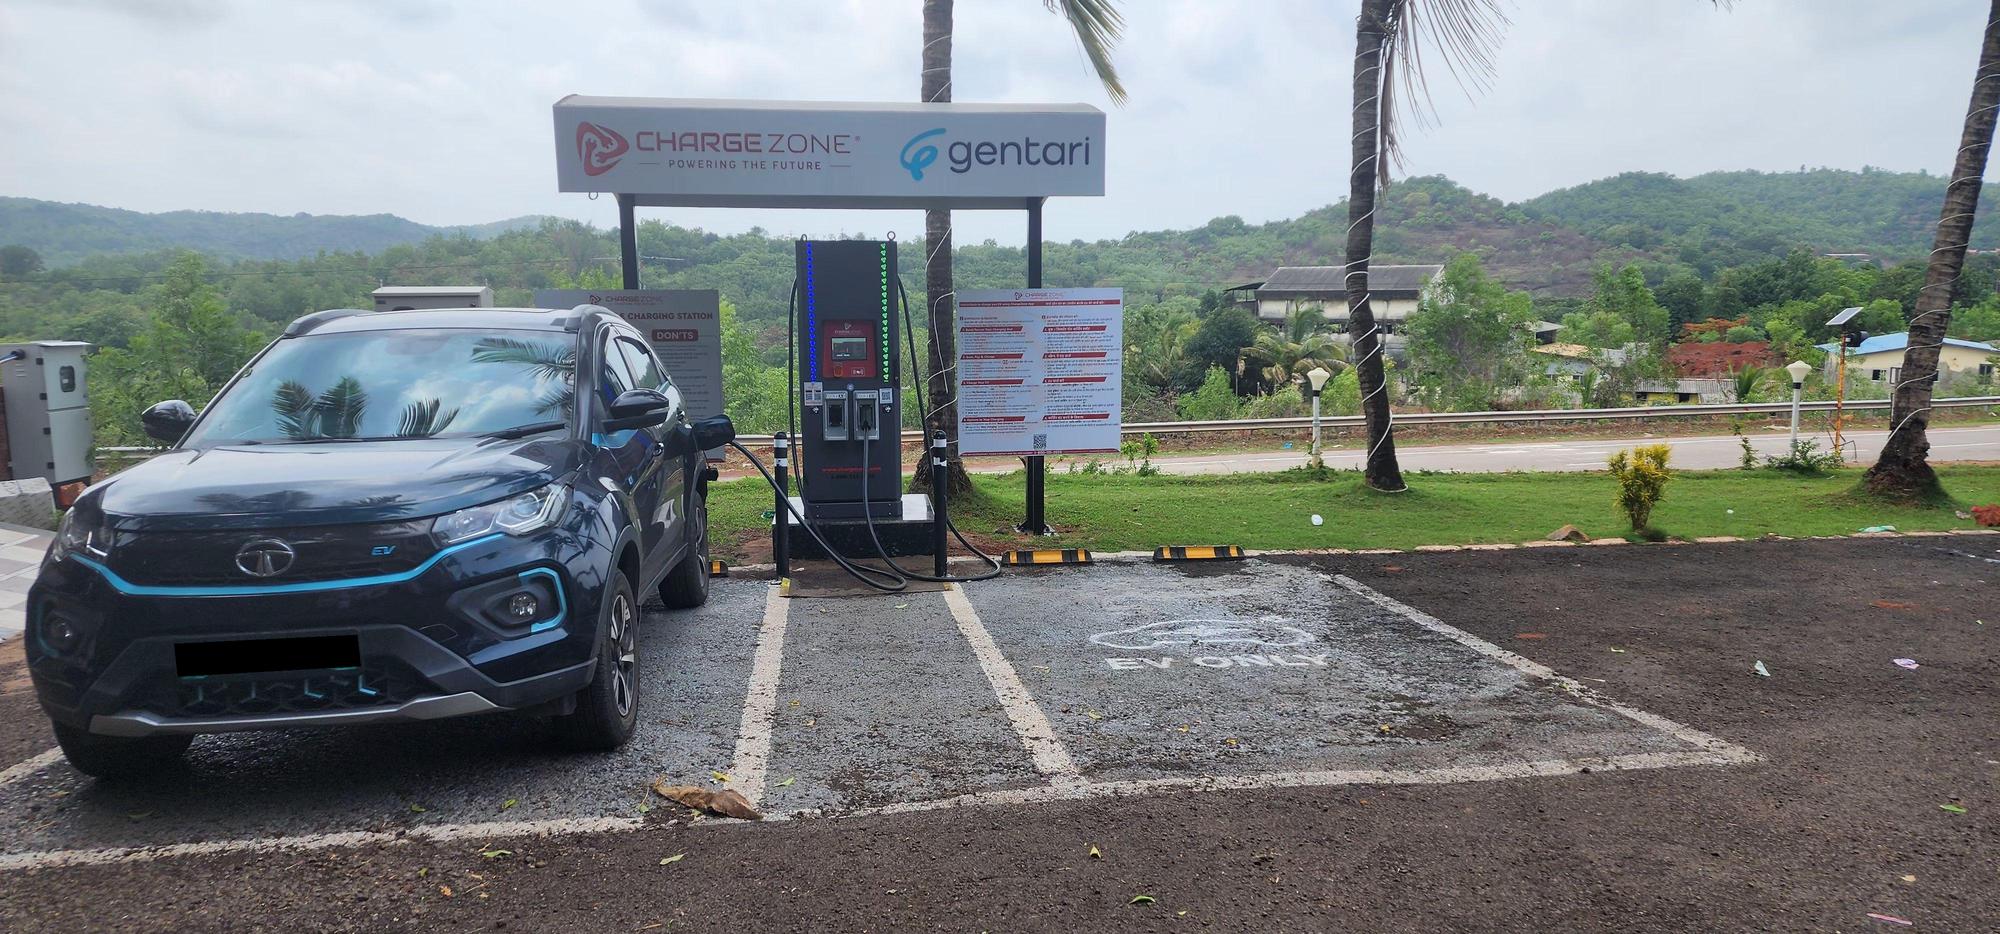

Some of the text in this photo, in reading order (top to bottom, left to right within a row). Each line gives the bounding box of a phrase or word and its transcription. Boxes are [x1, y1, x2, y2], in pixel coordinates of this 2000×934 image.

[948, 137, 1090, 174] gentari
[669, 159, 822, 170] POWERING THE FUTURE
[627, 312, 675, 320] CHARGING
[677, 312, 713, 320] STATION
[656, 331, 694, 340] DON'TS
[371, 545, 397, 556] EV
[1105, 654, 1328, 670] EV ONLY
